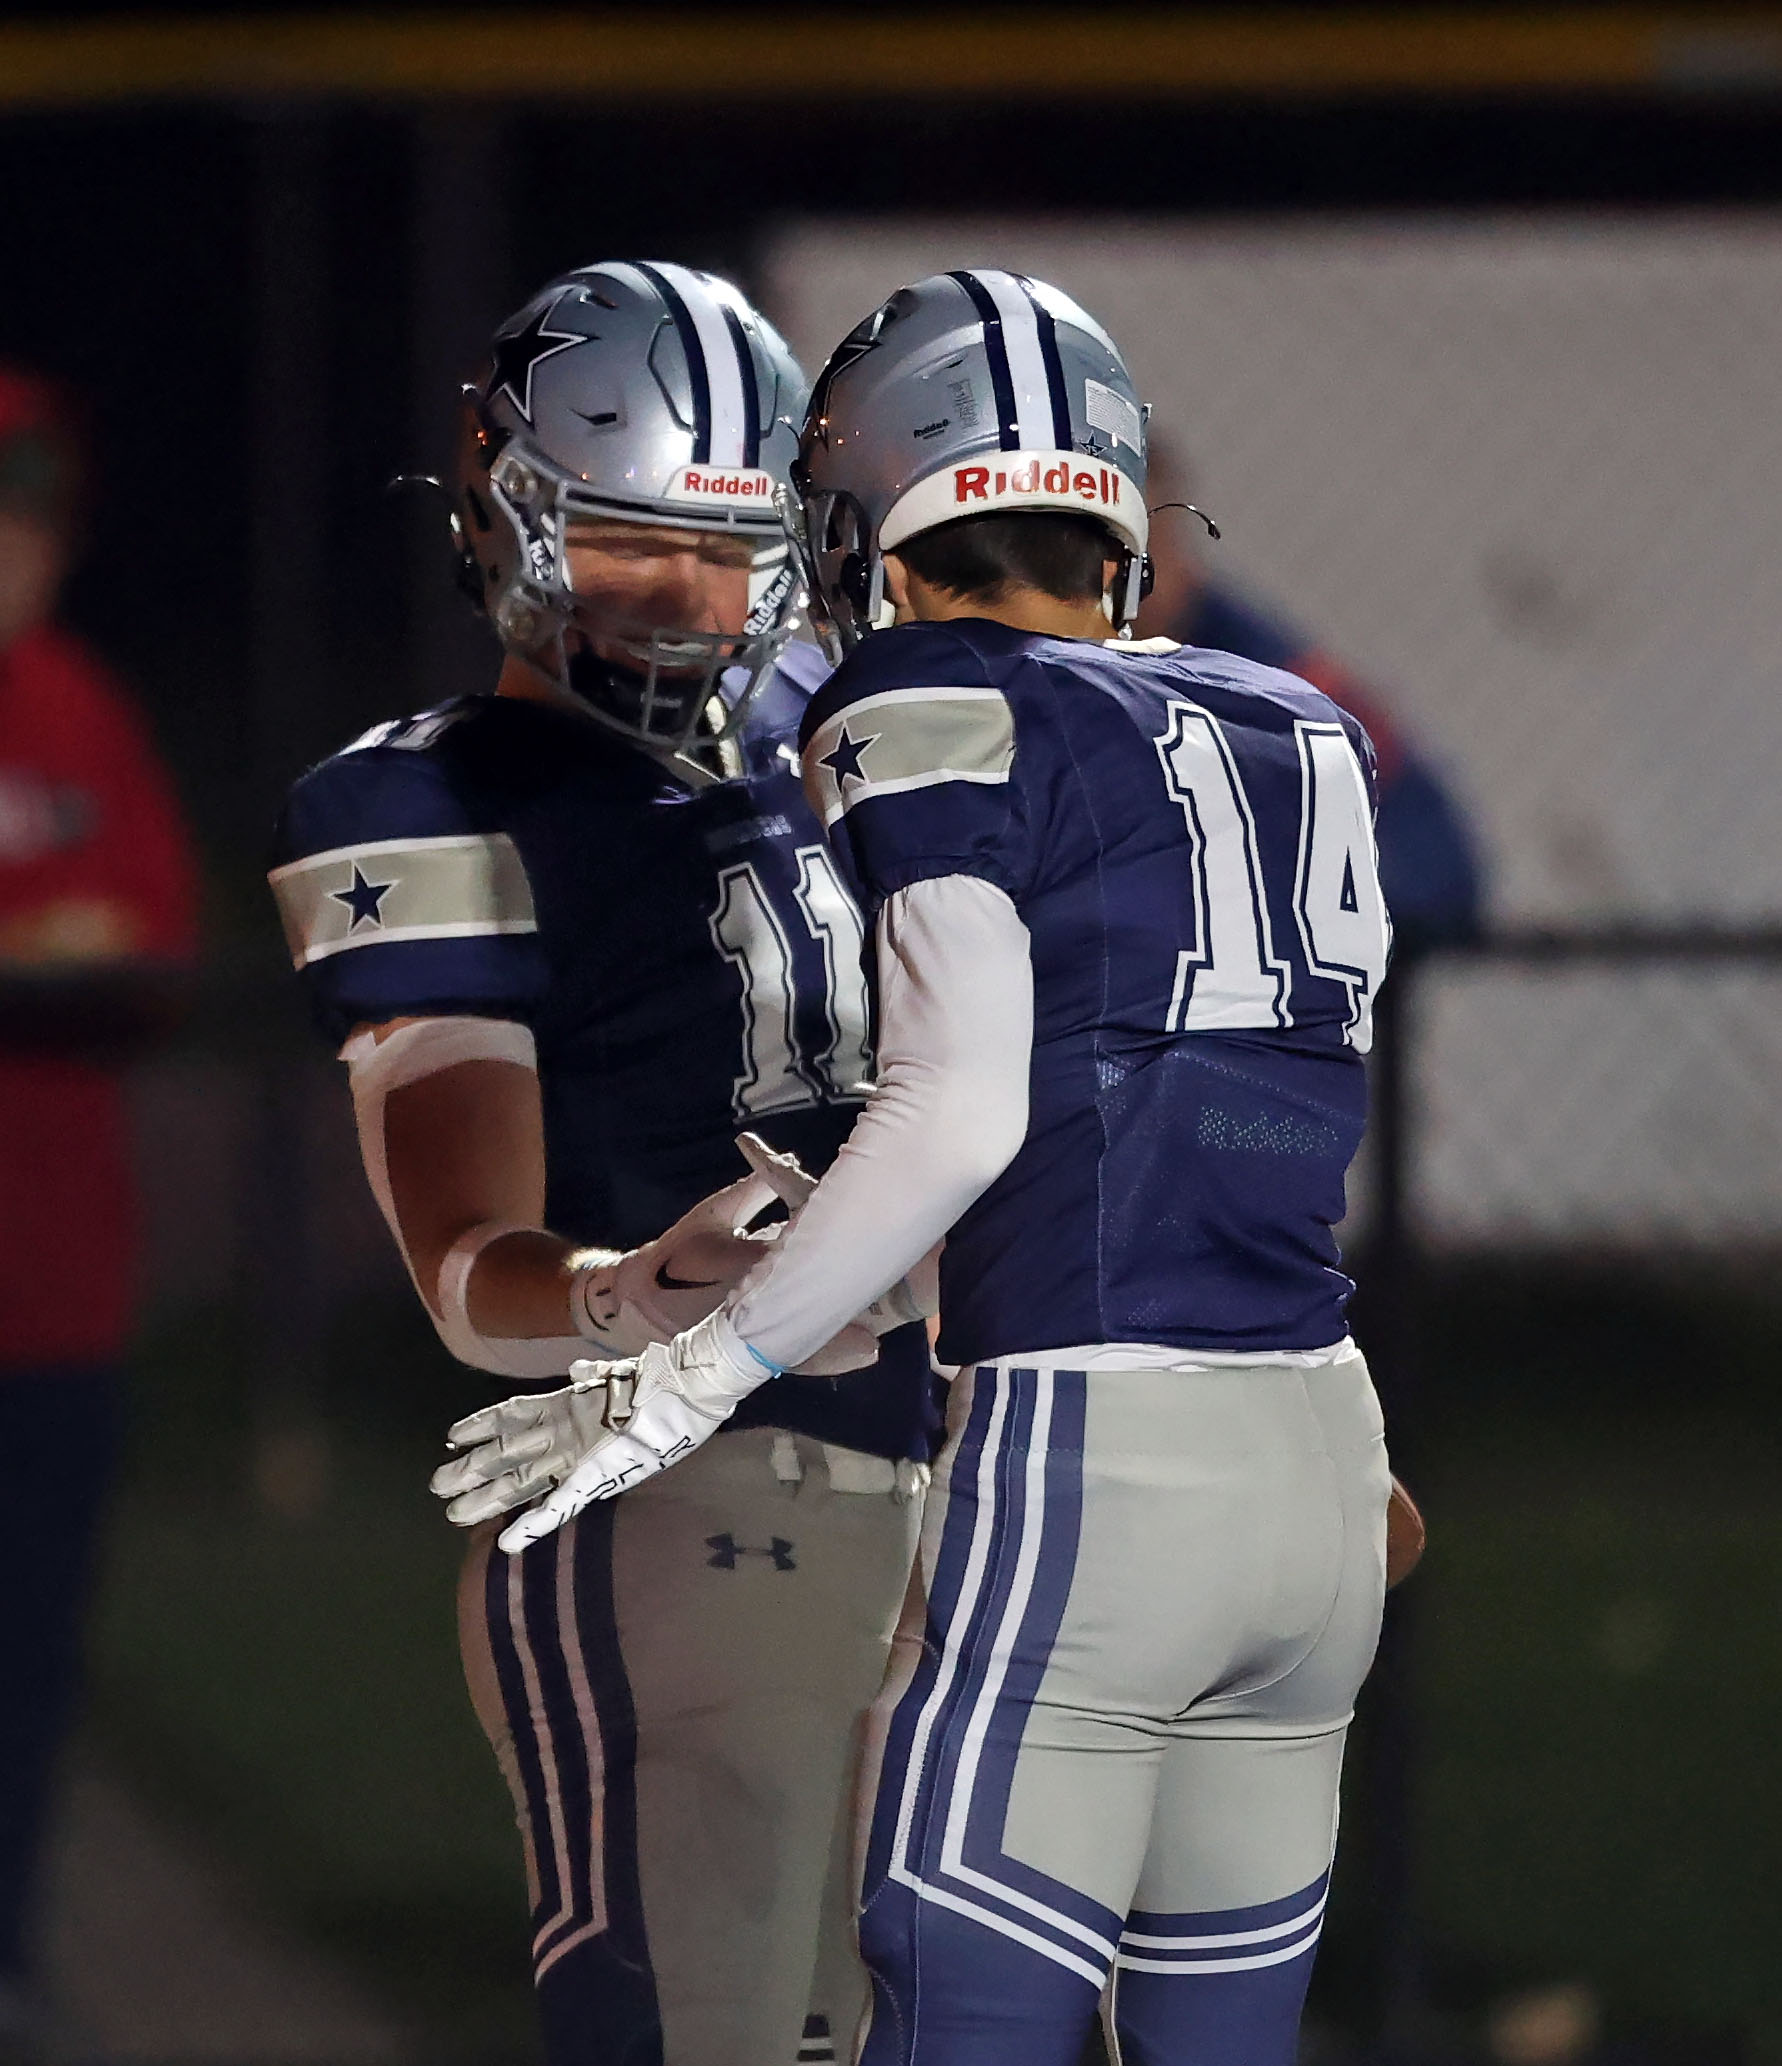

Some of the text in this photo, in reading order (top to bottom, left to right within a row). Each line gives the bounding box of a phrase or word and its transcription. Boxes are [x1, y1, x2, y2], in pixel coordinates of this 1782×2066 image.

[685, 472, 767, 495] Riddell
[955, 460, 1120, 505] Riddell
[743, 569, 793, 635] Riddell
[1153, 700, 1393, 1055] 14
[708, 844, 876, 1124] 11
